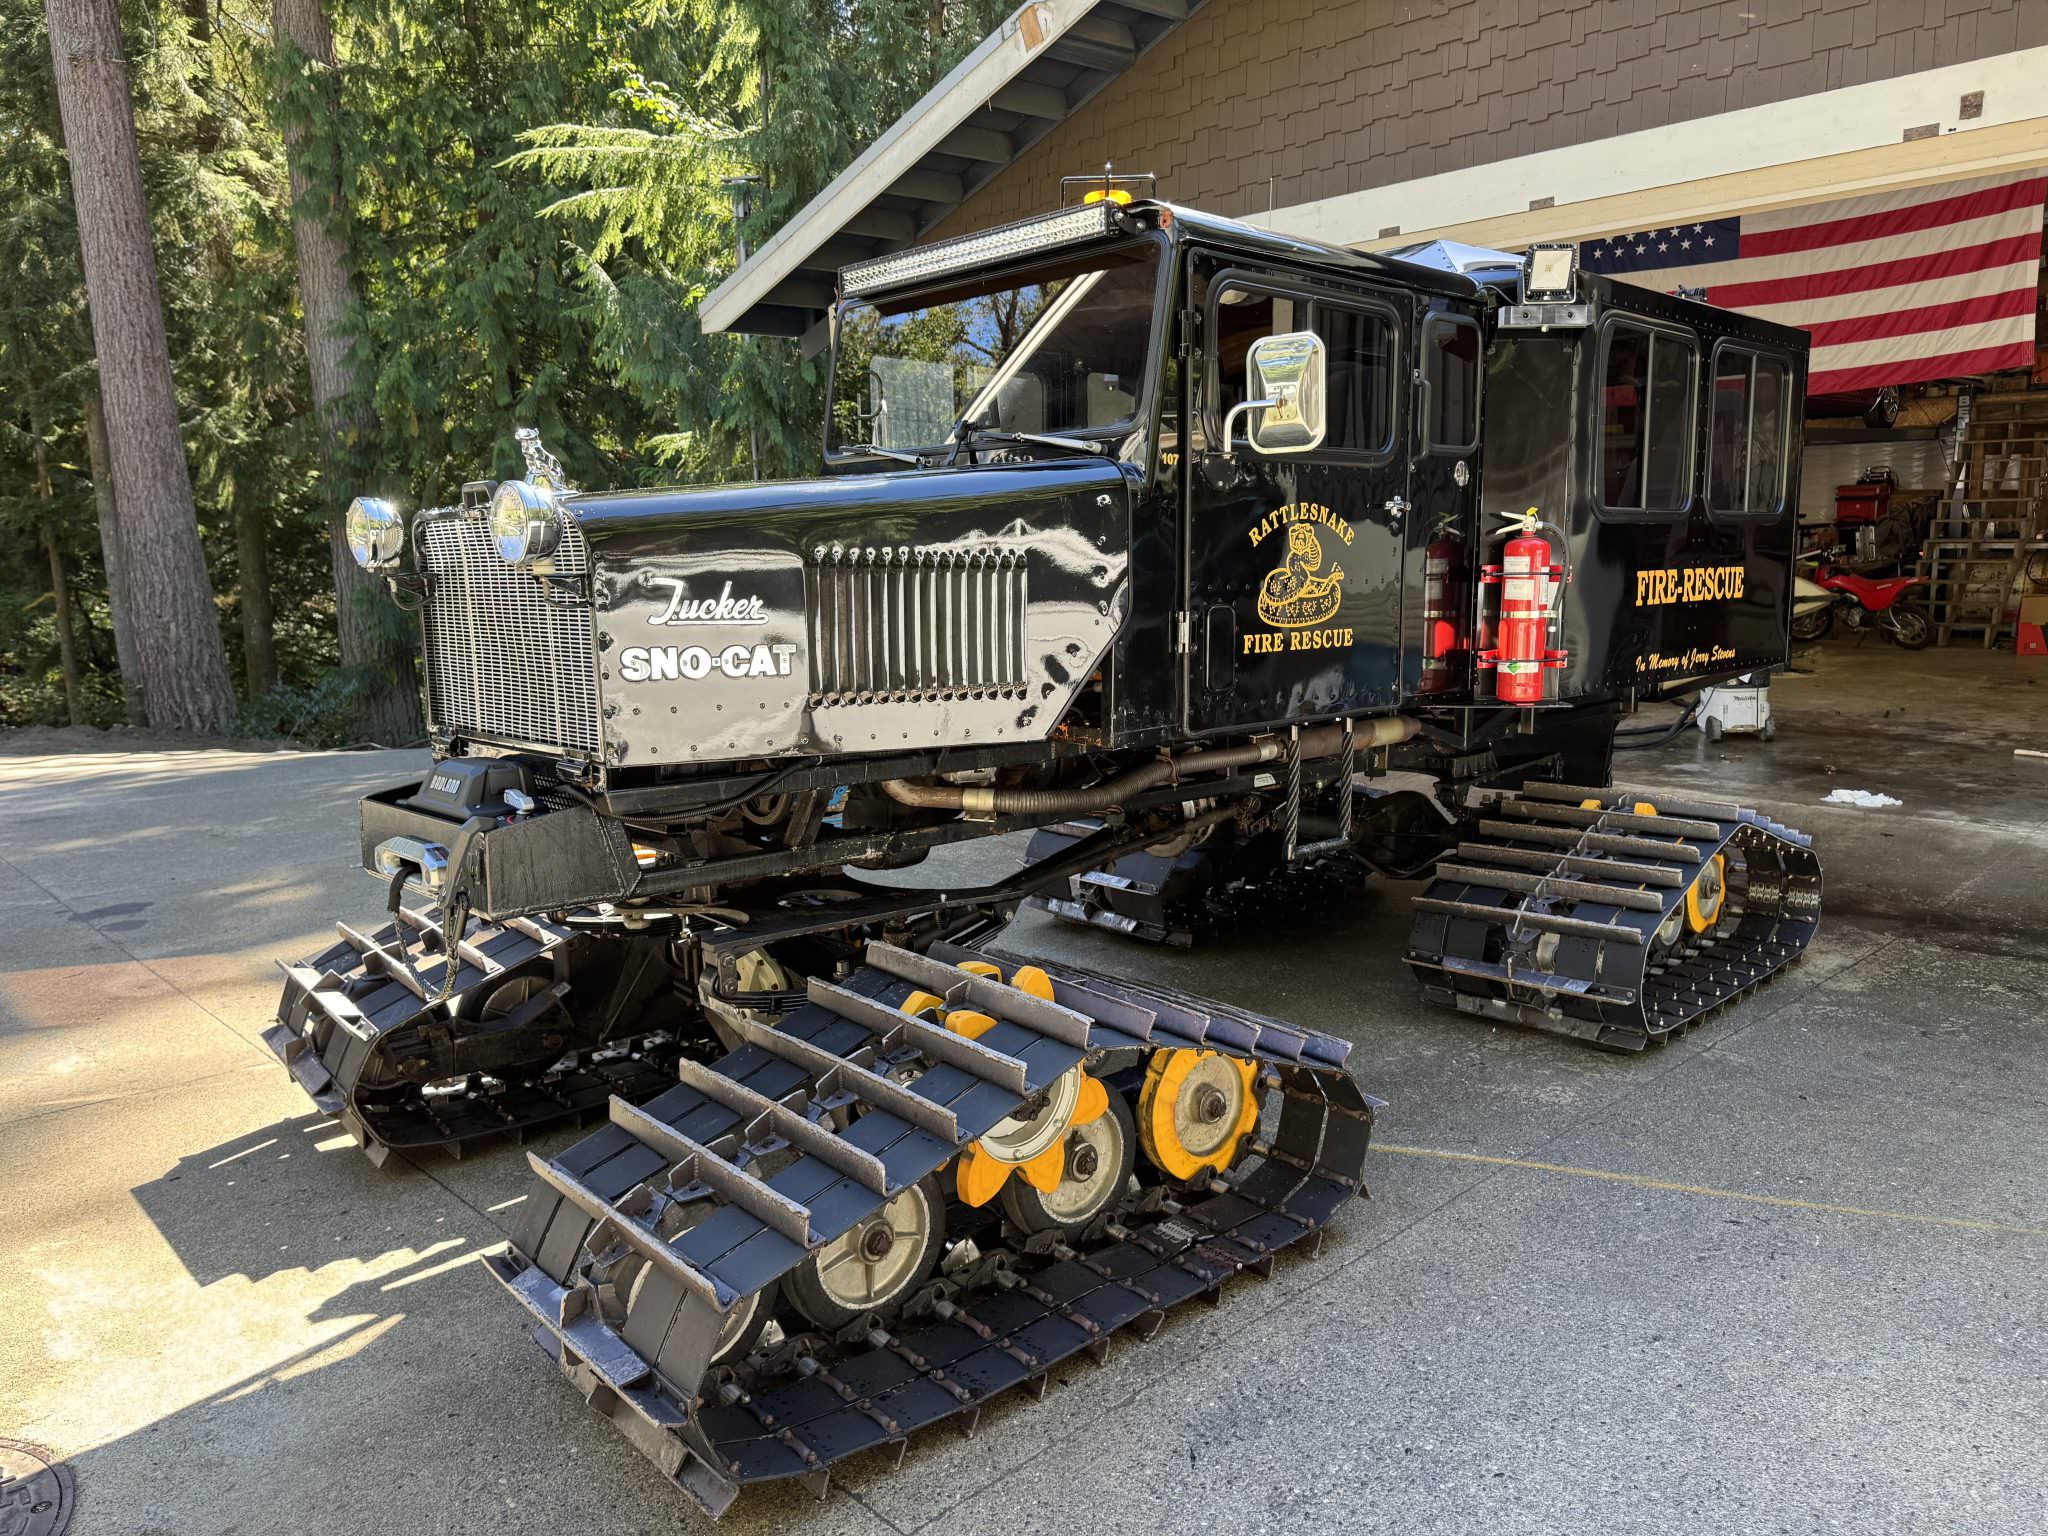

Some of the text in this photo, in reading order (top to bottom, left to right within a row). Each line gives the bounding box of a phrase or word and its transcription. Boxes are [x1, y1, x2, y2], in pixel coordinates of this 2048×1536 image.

[1161, 452, 1180, 466] 107
[1248, 502, 1355, 548] RATTLESNAKE
[647, 577, 769, 626] Tucker
[1635, 566, 1745, 607] FIRE-RESCUE
[1243, 628, 1354, 655] FIRE RESCUE
[1635, 656, 1646, 673] In
[1648, 653, 1680, 671] Memory
[1681, 649, 1690, 670] of
[1711, 644, 1736, 662] Stevens
[619, 643, 798, 682] SNO-CAT
